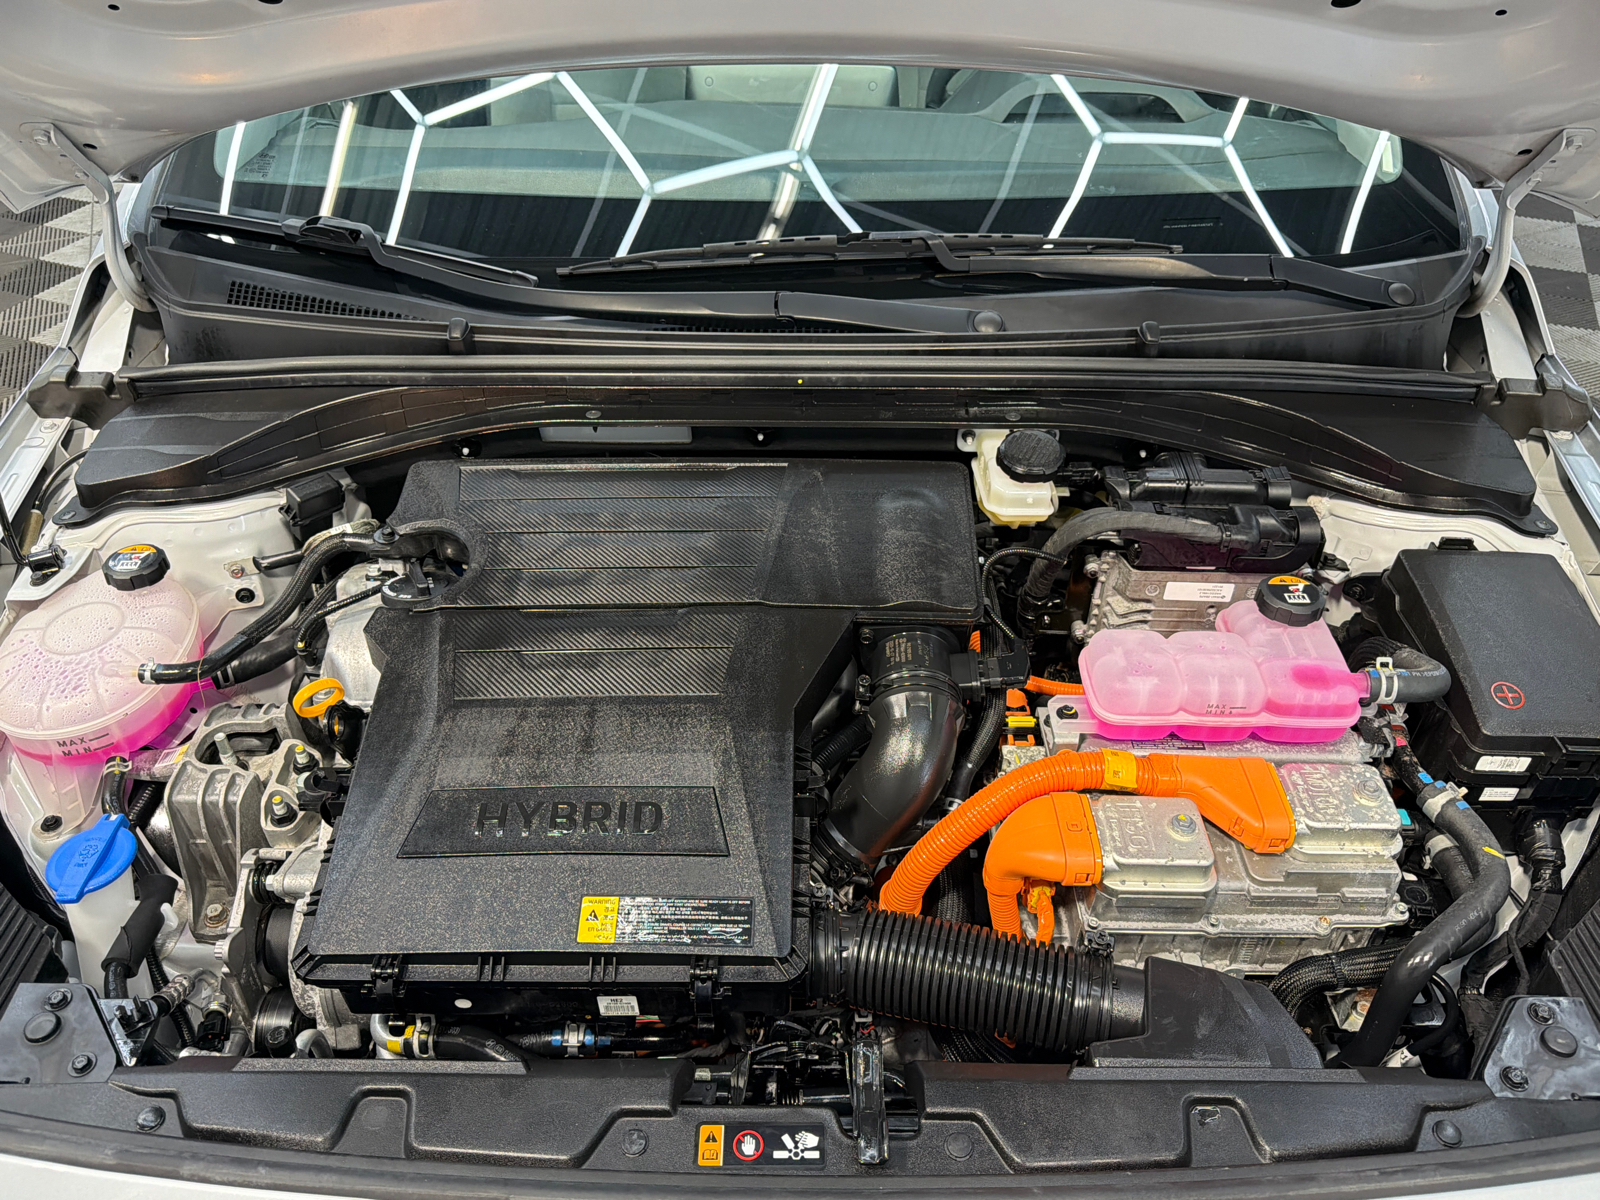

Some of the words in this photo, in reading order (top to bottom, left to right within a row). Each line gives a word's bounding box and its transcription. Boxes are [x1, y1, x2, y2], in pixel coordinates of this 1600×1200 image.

[57, 737, 87, 748] MAX
[62, 746, 92, 757] MIN
[476, 801, 663, 837] HYBRID
